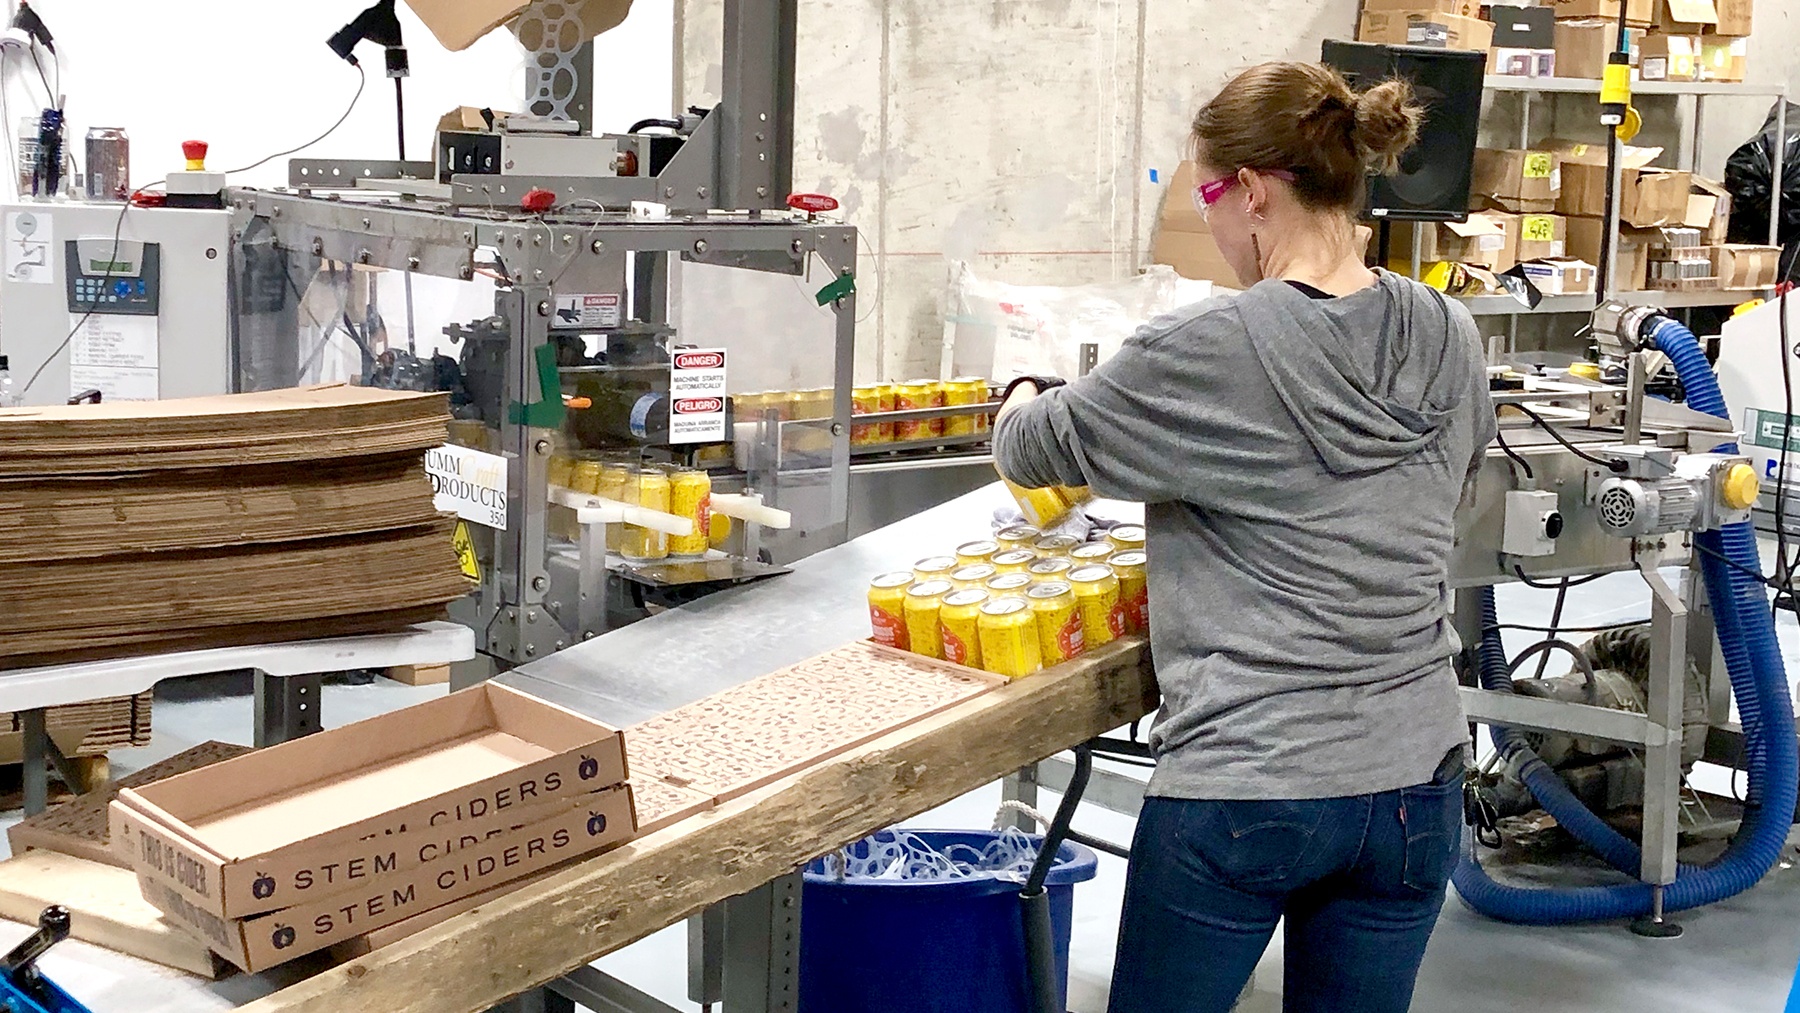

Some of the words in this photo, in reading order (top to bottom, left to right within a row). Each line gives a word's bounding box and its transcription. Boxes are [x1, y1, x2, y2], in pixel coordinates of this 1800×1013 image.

[681, 355, 718, 366] DANGER
[673, 375, 700, 383] MACHINE
[702, 374, 724, 382] STARTS
[675, 382, 722, 391] AUTOMATICALLY
[680, 400, 717, 411] PELIGRO
[489, 510, 505, 527] 350
[294, 851, 397, 890] STEM
[314, 884, 416, 934] STEM
[436, 828, 571, 890] CIDERS
